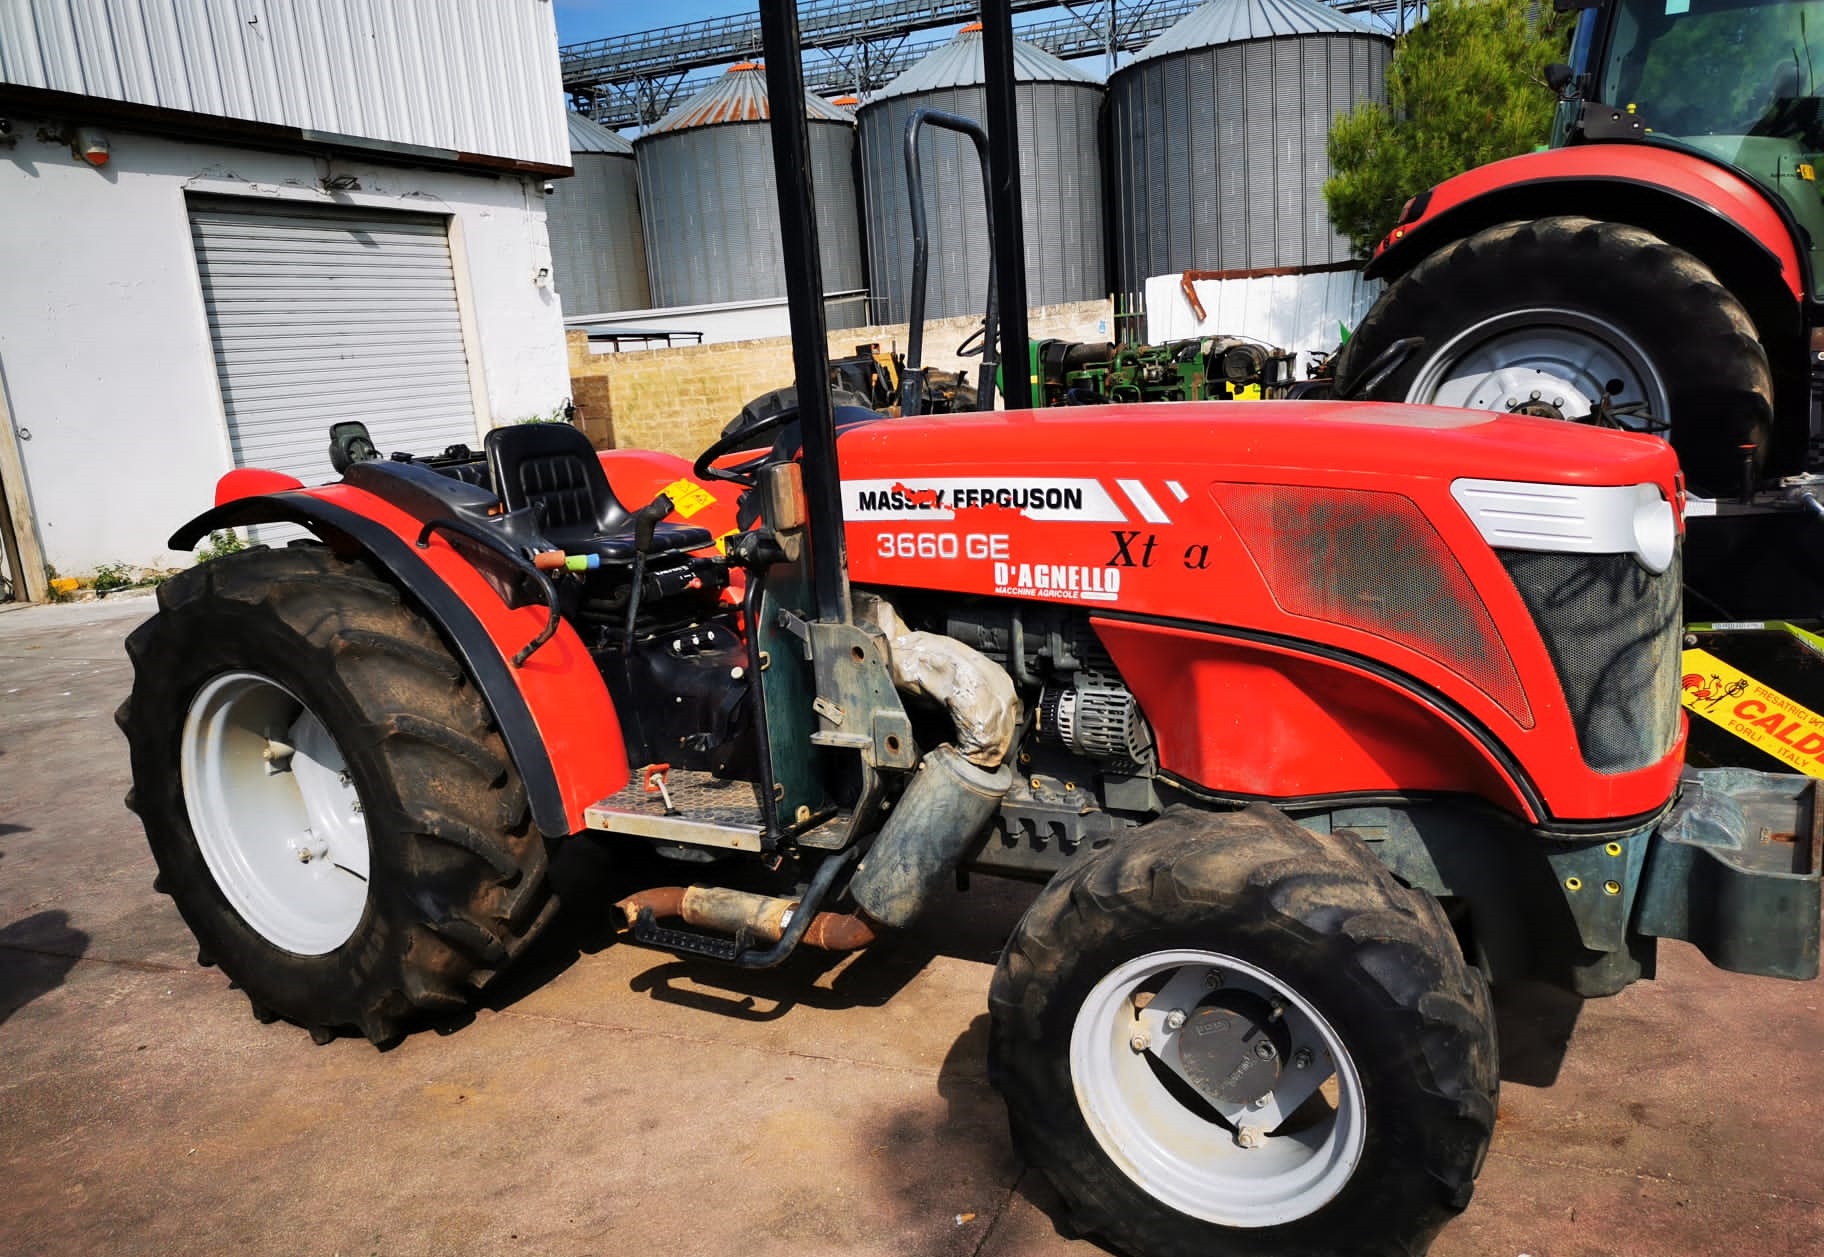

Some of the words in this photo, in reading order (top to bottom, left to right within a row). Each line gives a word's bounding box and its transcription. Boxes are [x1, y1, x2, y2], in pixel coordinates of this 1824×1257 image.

[876, 532, 960, 559] 3660
[965, 532, 1011, 560] GE
[993, 561, 1121, 593] D'AGNELLO
[994, 586, 1037, 597] MACCHINE
[1037, 588, 1080, 600] AGRICOLE
[1777, 746, 1810, 768] ITALY
